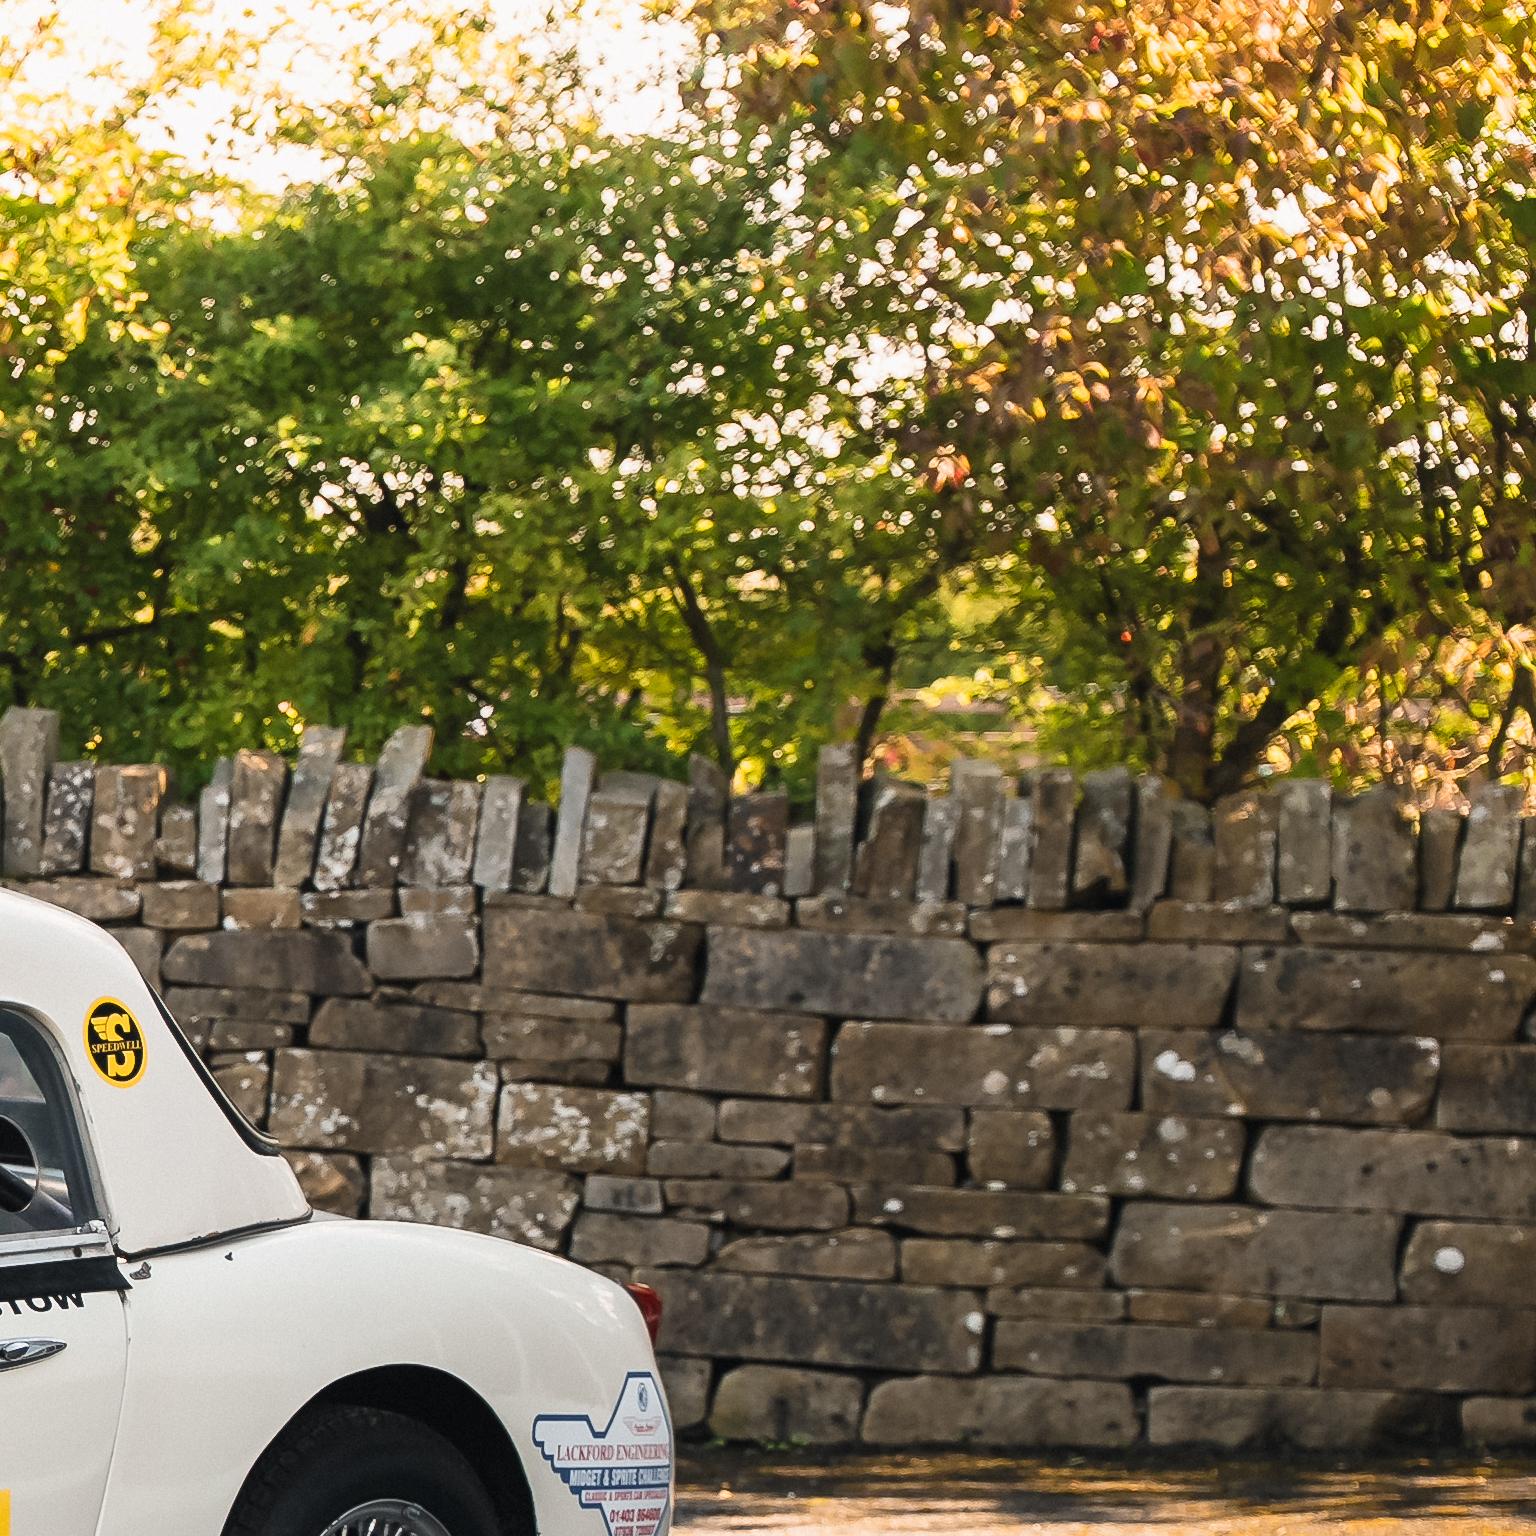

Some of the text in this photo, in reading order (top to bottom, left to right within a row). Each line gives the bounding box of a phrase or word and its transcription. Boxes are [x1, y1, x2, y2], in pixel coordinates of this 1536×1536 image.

[91, 1040, 142, 1053] SPEEDWELL
[556, 1444, 614, 1461] LACKFORD
[569, 1469, 602, 1486] MIDGET
